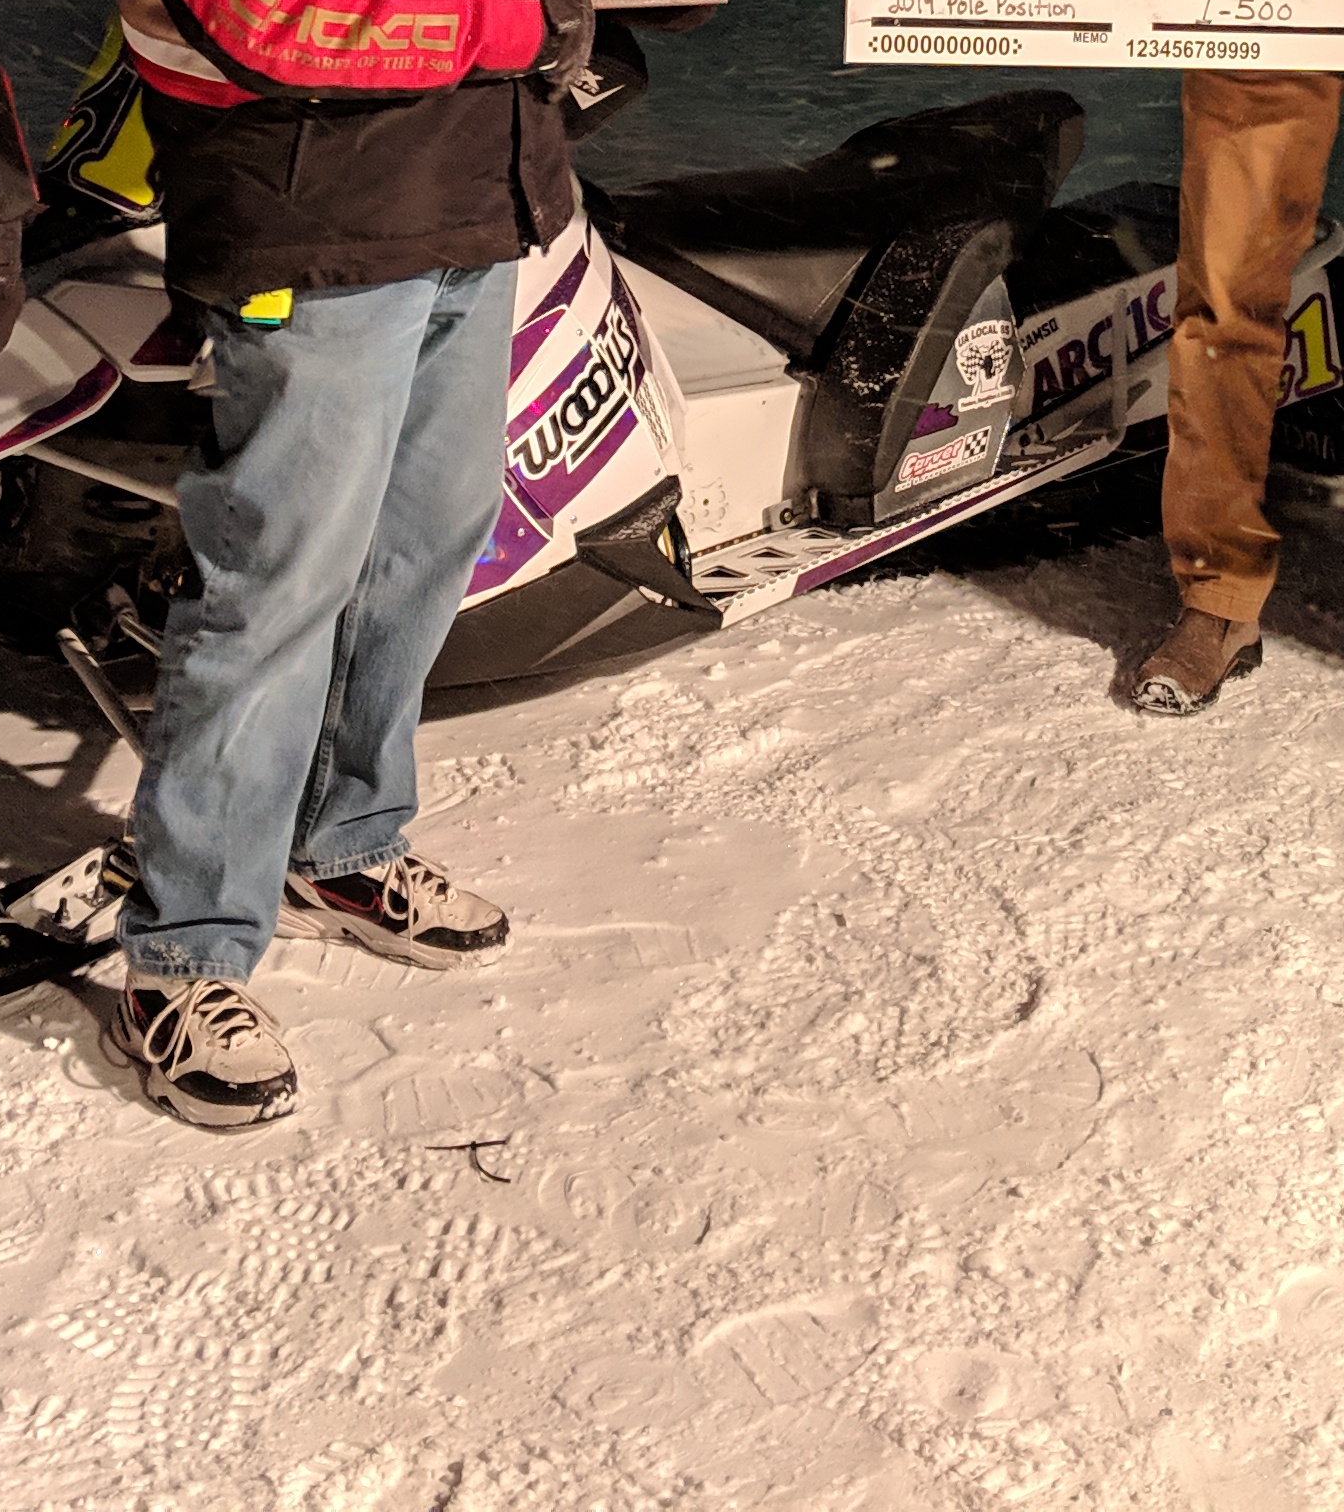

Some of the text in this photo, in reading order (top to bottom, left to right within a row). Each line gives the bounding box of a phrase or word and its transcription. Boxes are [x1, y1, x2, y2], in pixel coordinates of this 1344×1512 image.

[1072, 32, 1109, 44] MEMO
[1125, 39, 1261, 60] 123456789999
[357, 55, 379, 69] OF
[383, 55, 414, 70] THE
[417, 56, 453, 73] I-500
[971, 323, 999, 340] LOCAL
[1030, 280, 1172, 418] ARCIC
[899, 437, 964, 481] Carver
